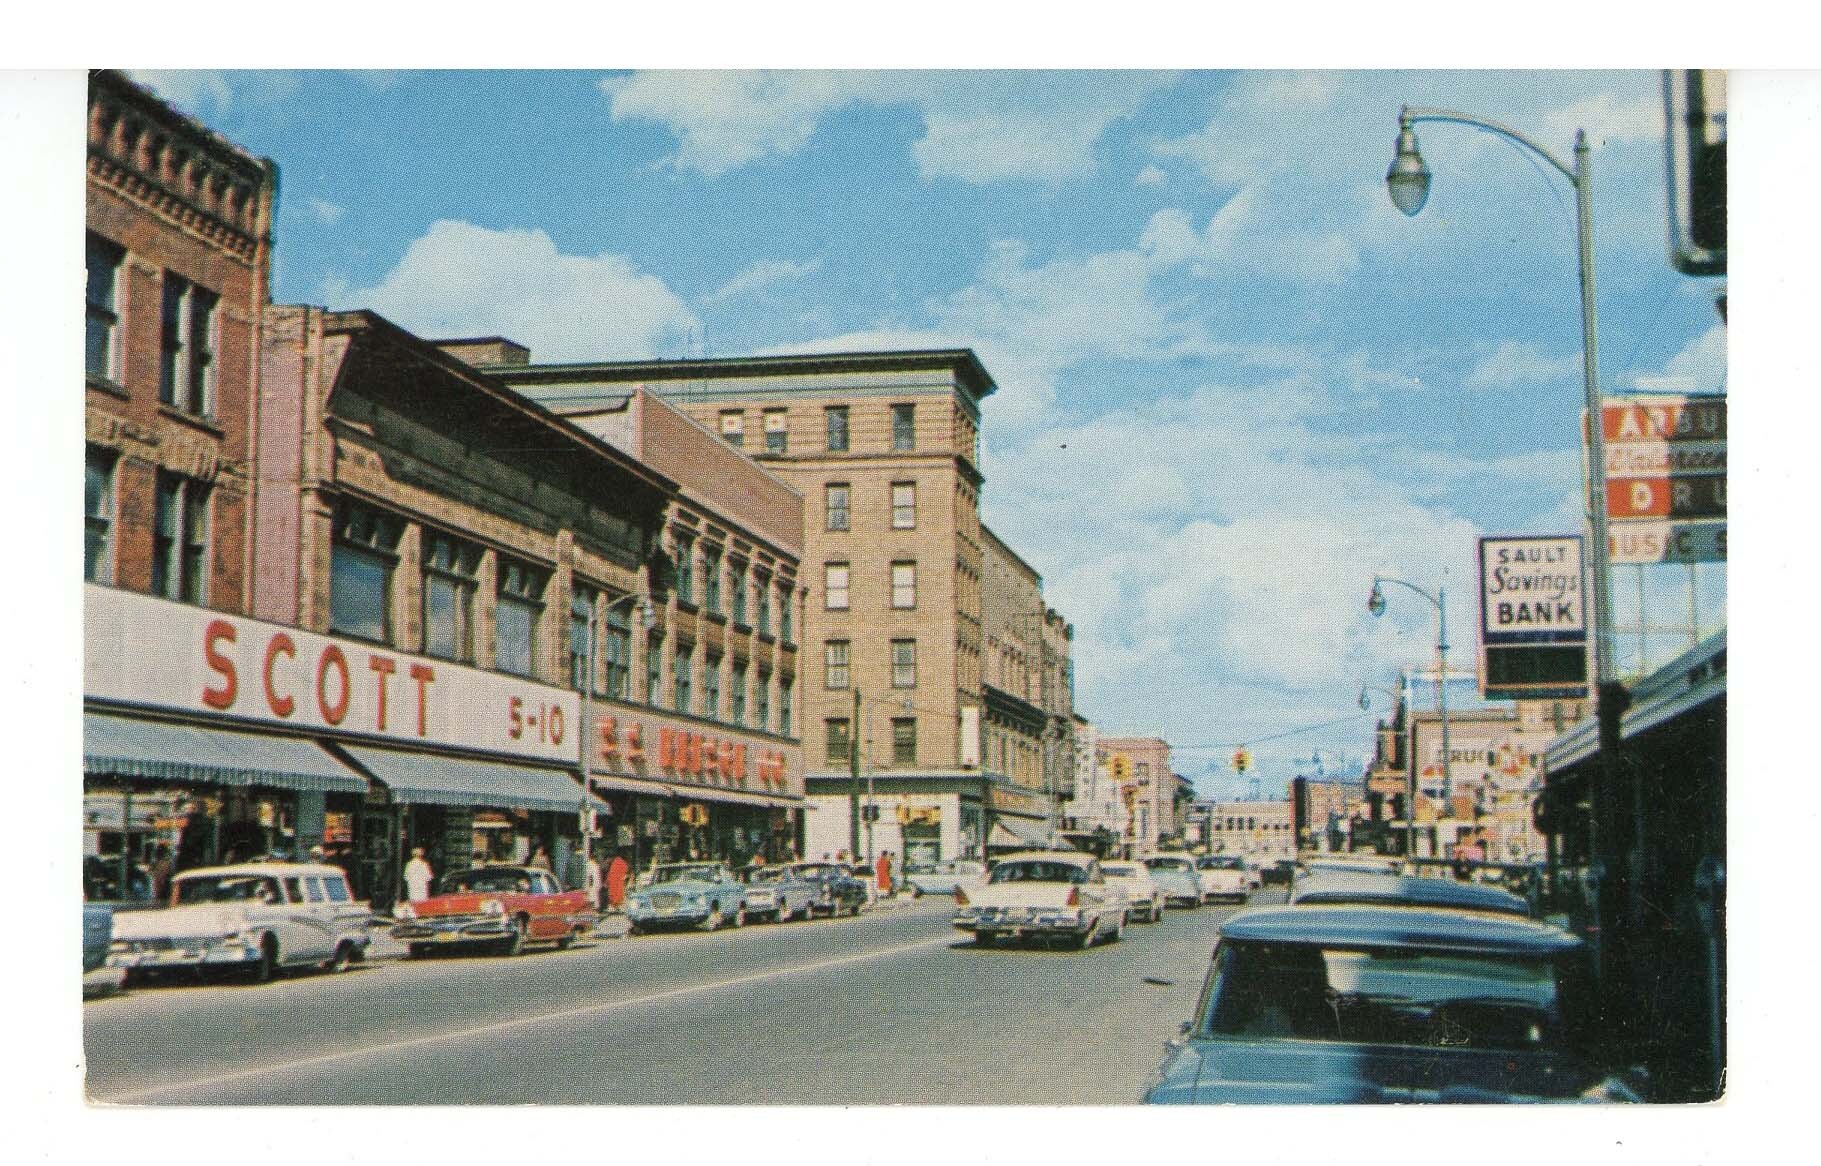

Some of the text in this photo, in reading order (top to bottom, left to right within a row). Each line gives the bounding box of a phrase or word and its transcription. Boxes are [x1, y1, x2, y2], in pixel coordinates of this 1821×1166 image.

[1497, 546, 1566, 564] SAULT
[1490, 566, 1578, 600] Savings
[1498, 601, 1574, 625] BANK
[202, 619, 564, 745] SCOTT 5-10
